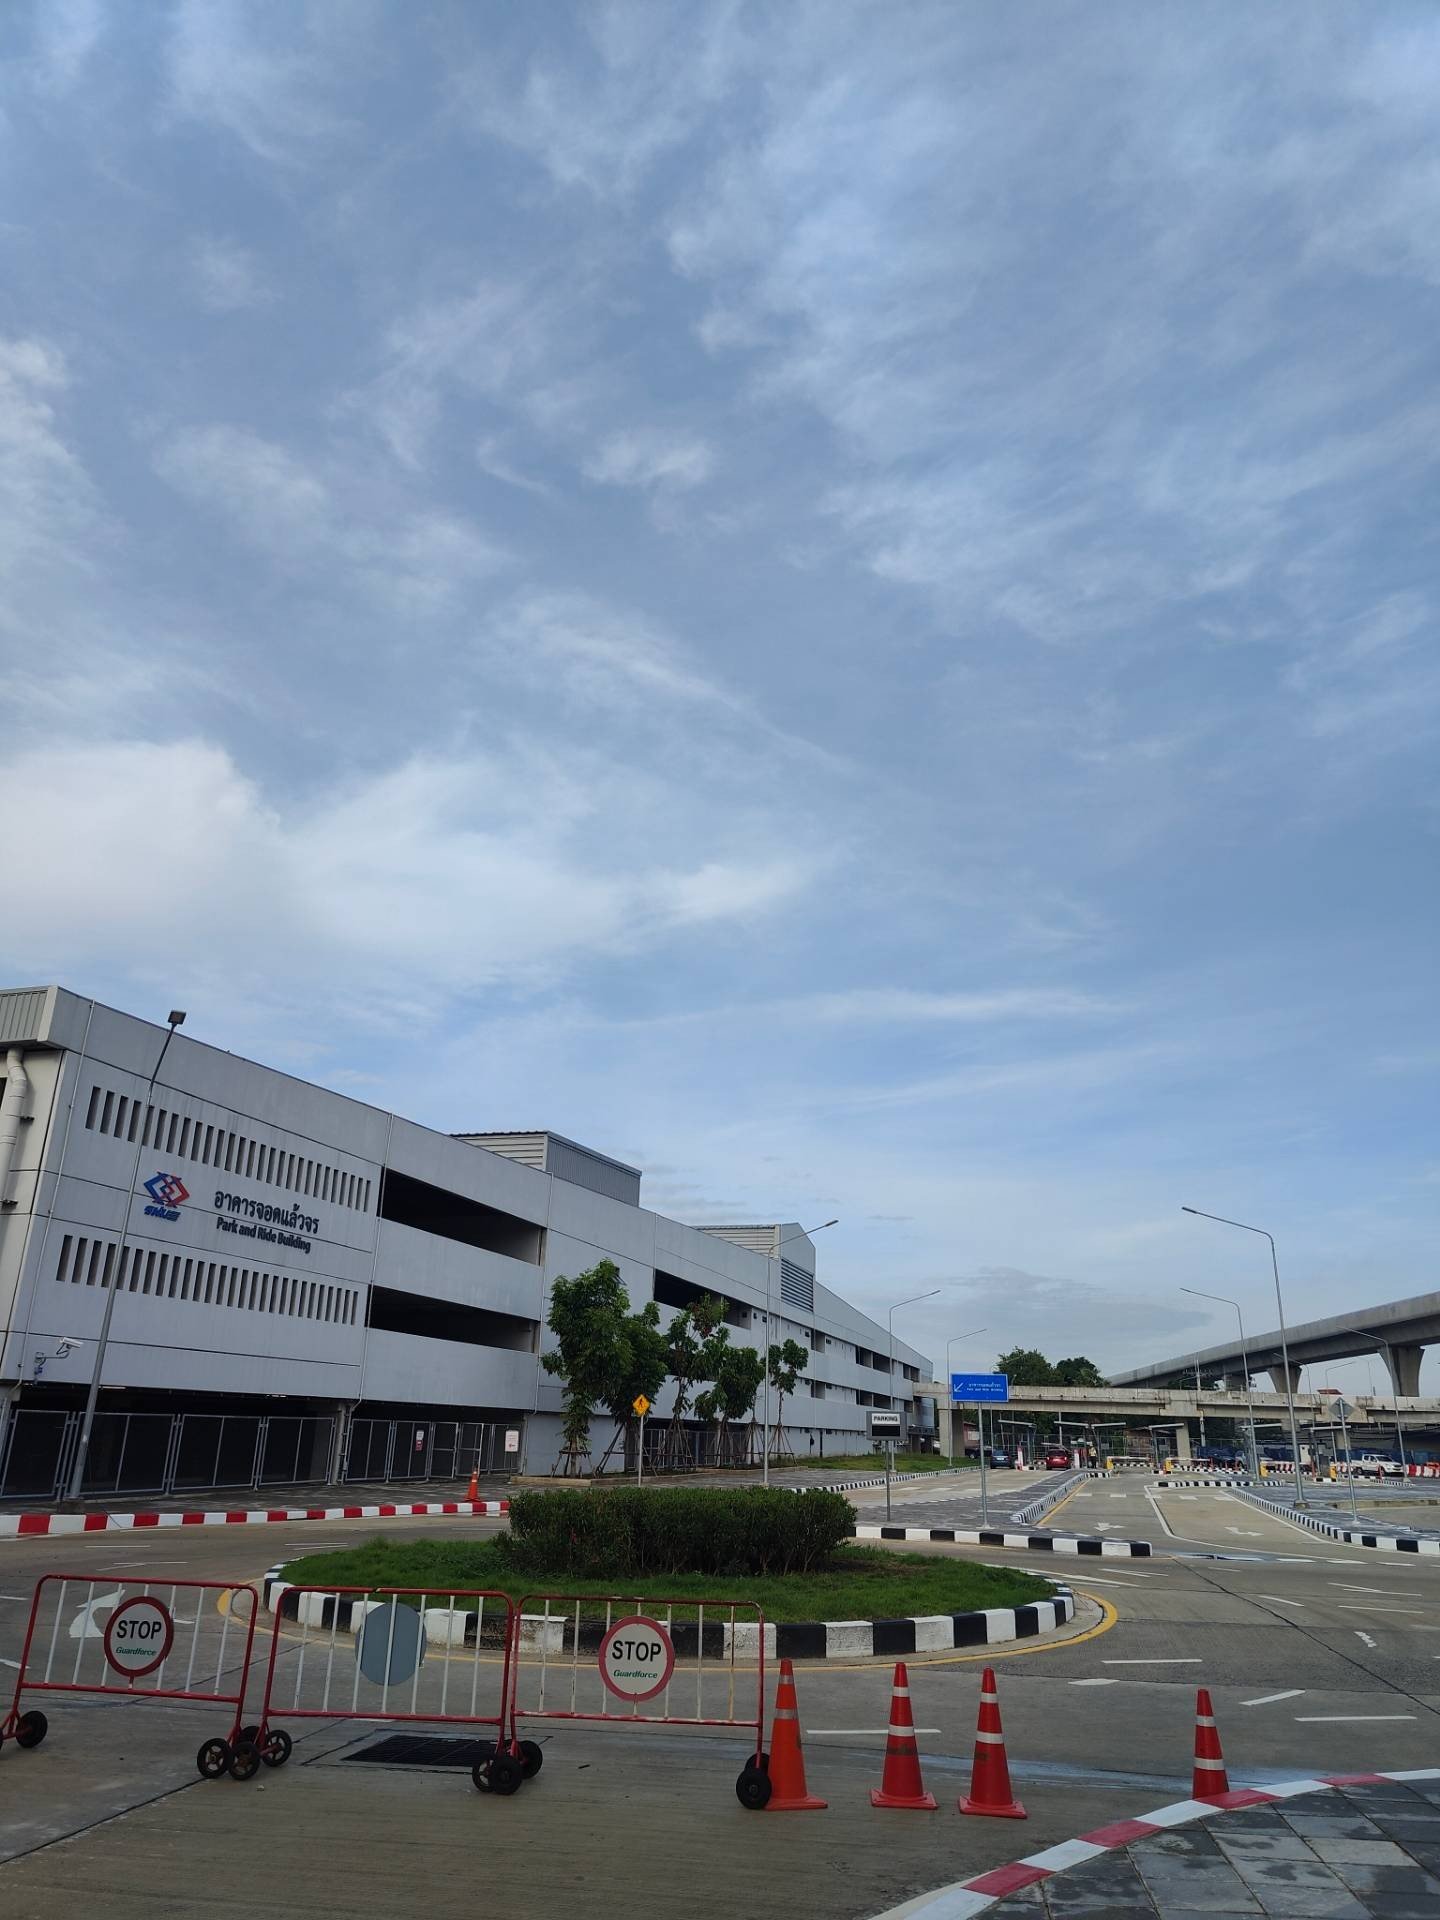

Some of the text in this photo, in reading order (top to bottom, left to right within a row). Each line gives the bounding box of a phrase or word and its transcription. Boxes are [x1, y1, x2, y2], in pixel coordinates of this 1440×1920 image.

[214, 1190, 320, 1234] อาคารจอดแล้วจร
[216, 1216, 312, 1254] Park and Ride Building
[116, 1619, 162, 1640] STOP
[115, 1645, 157, 1657] Guardforce
[611, 1639, 662, 1662] STOP
[613, 1669, 658, 1679] Guardforce
